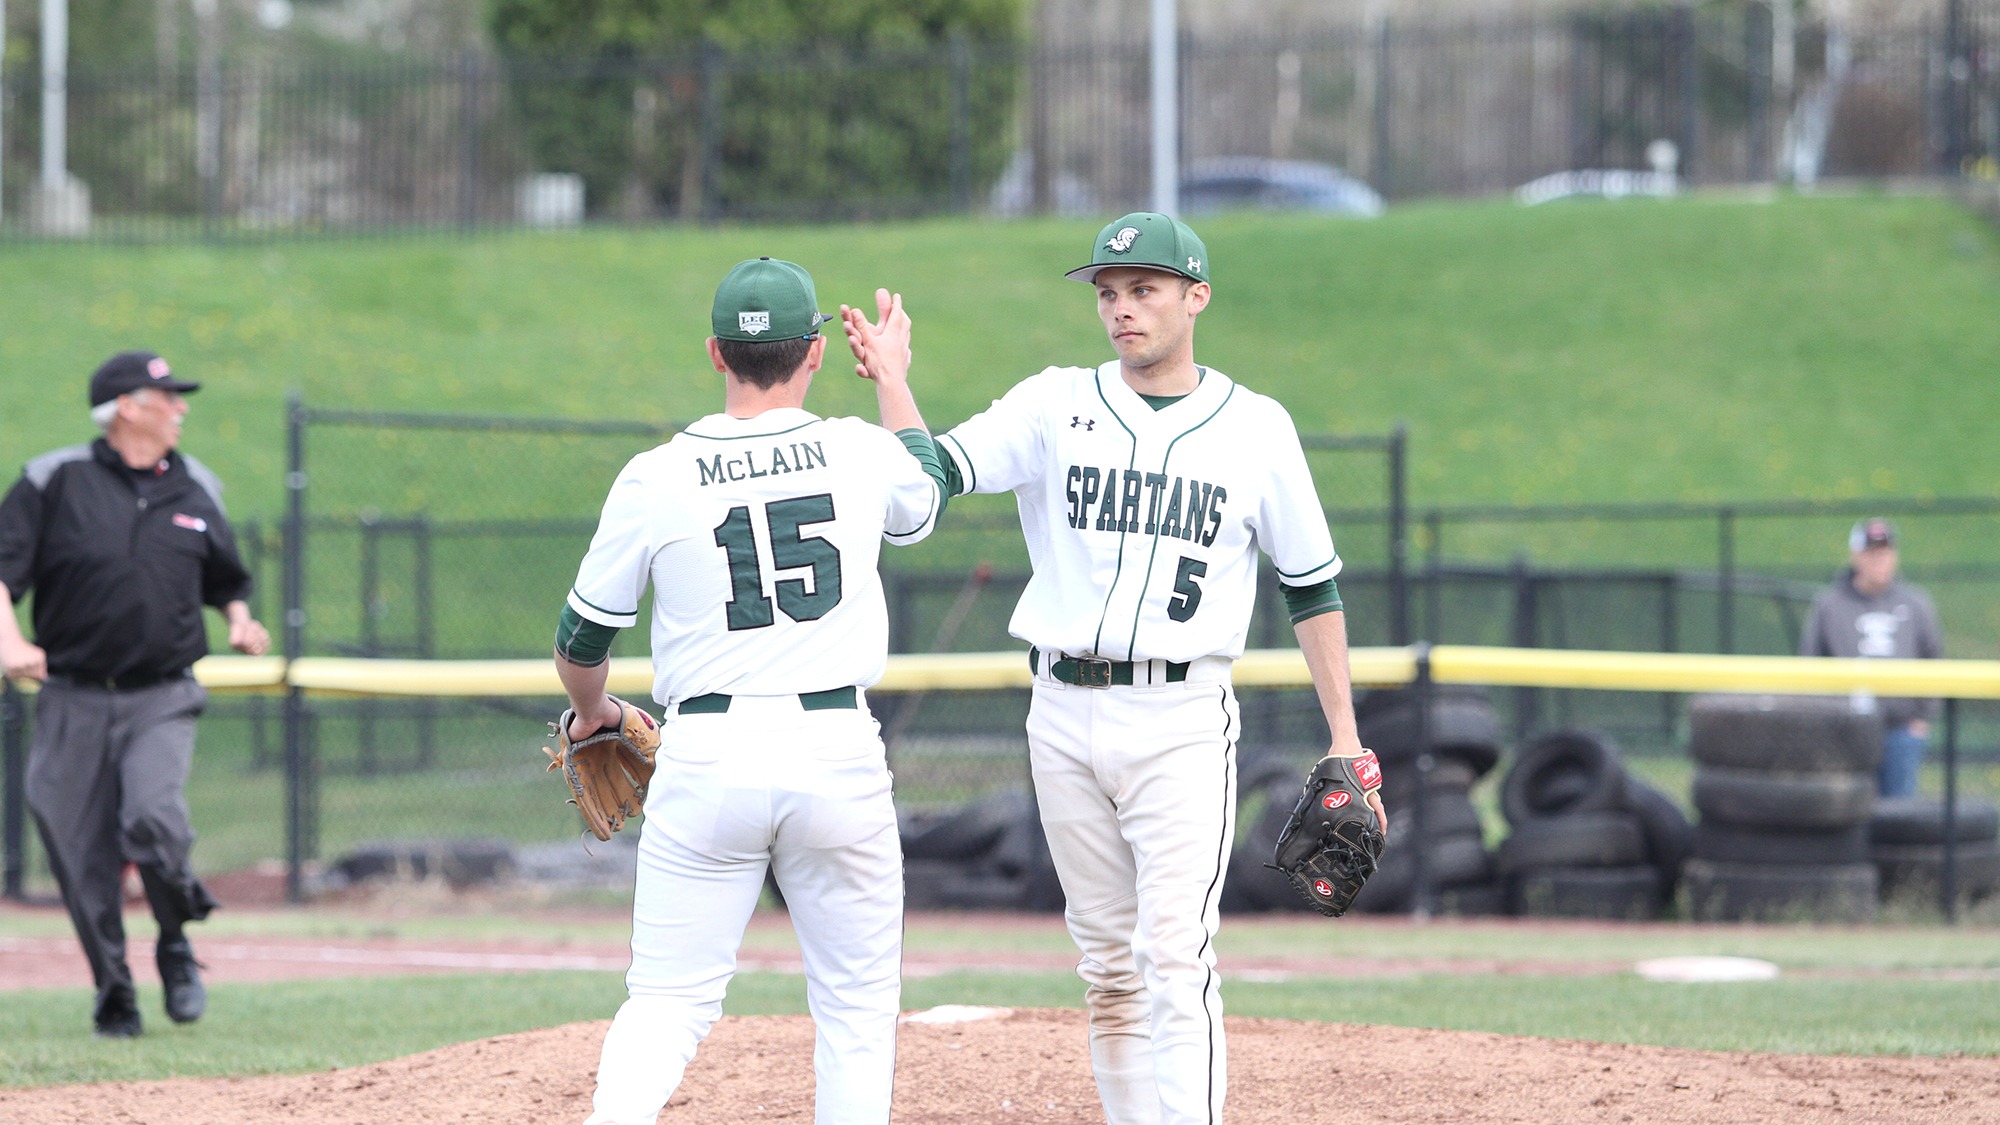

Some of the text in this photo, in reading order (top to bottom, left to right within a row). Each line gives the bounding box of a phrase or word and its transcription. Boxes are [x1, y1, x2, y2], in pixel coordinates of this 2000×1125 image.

[741, 316, 767, 324] LEC
[696, 441, 827, 486] McLAIN
[1066, 465, 1227, 548] SPARTANS
[713, 493, 842, 631] 15
[1167, 555, 1208, 623] 5
